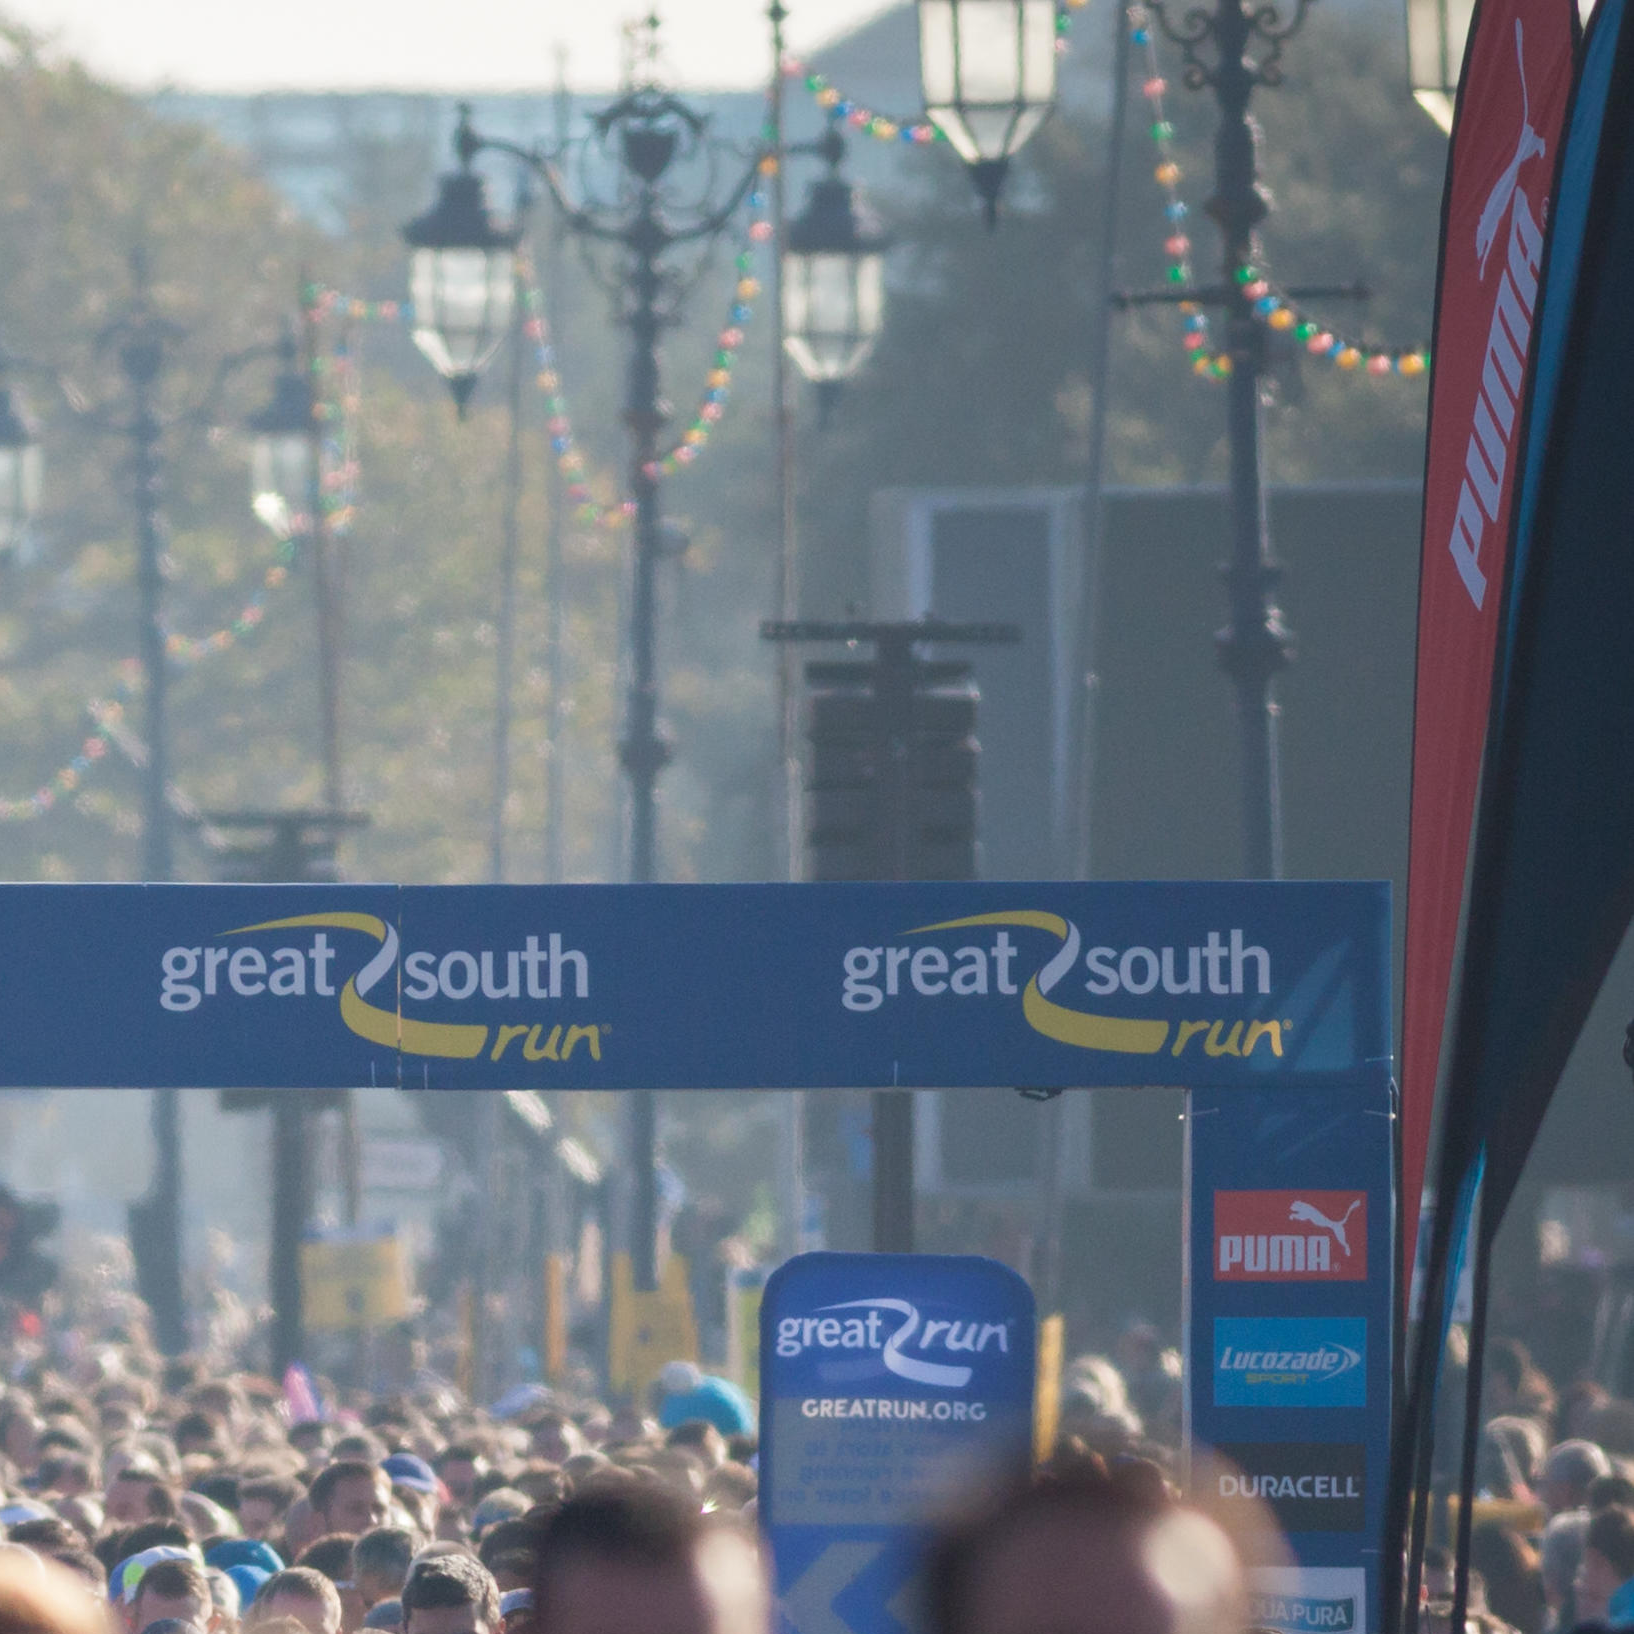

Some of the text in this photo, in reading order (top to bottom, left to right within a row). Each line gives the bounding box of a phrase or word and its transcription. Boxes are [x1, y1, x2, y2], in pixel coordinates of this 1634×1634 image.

[1448, 185, 1544, 611] PUMA
[160, 933, 589, 1012] great south
[842, 929, 1271, 1012] great south
[490, 1024, 601, 1062] run
[1171, 1018, 1283, 1059] run
[1219, 1234, 1331, 1273] PUMA
[776, 1310, 1009, 1358] great run
[800, 1398, 987, 1421] GREATRUN.ORG
[1219, 1474, 1361, 1499] DURACELL
[1291, 1603, 1348, 1627] PURA
